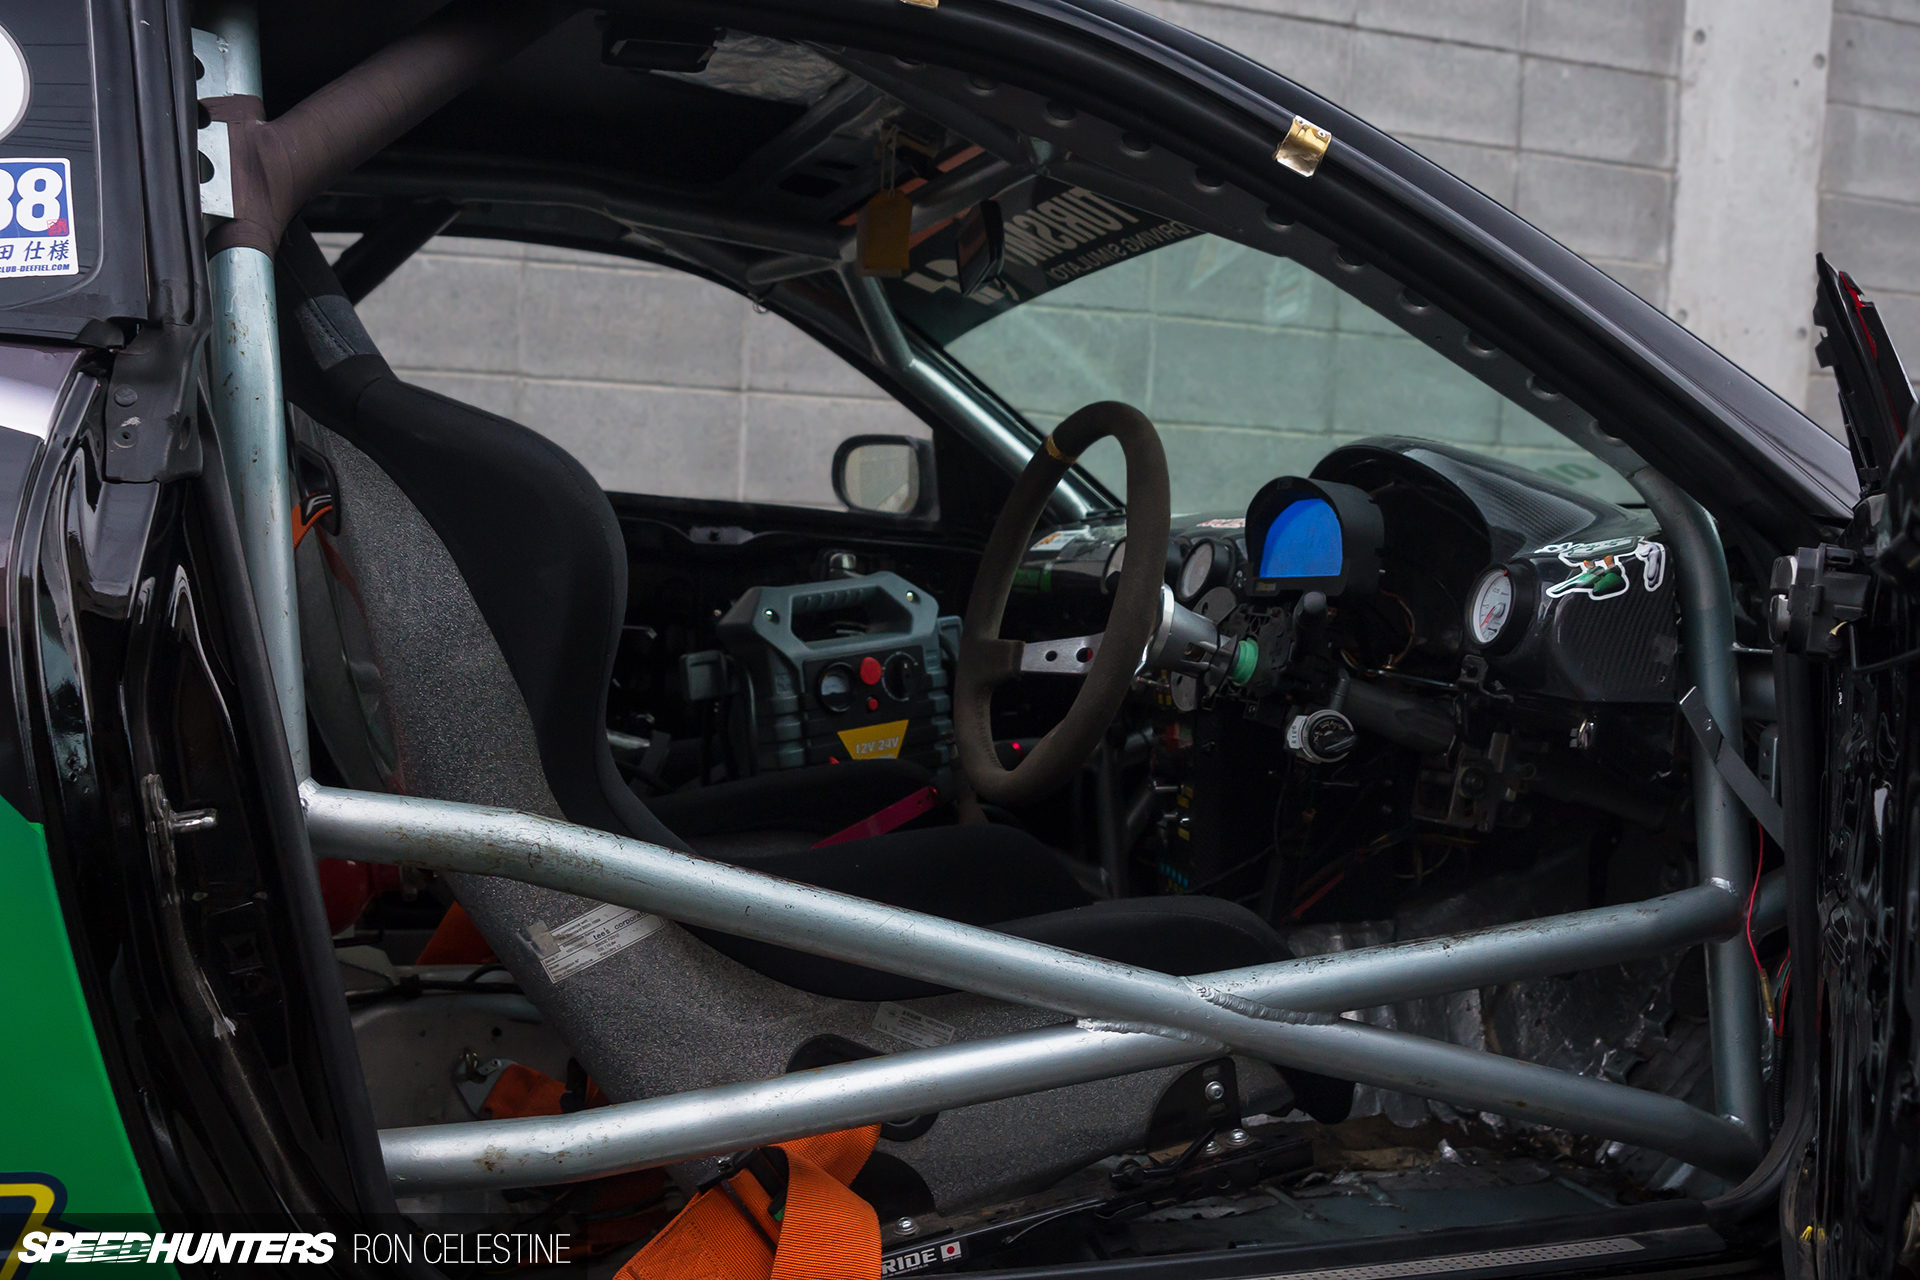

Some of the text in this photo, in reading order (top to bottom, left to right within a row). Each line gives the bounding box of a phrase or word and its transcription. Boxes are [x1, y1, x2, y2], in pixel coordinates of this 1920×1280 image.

[855, 736, 900, 755] 12V 24V
[592, 926, 611, 940] tee's
[614, 911, 646, 930] corporat
[882, 1248, 937, 1274] RIDE
